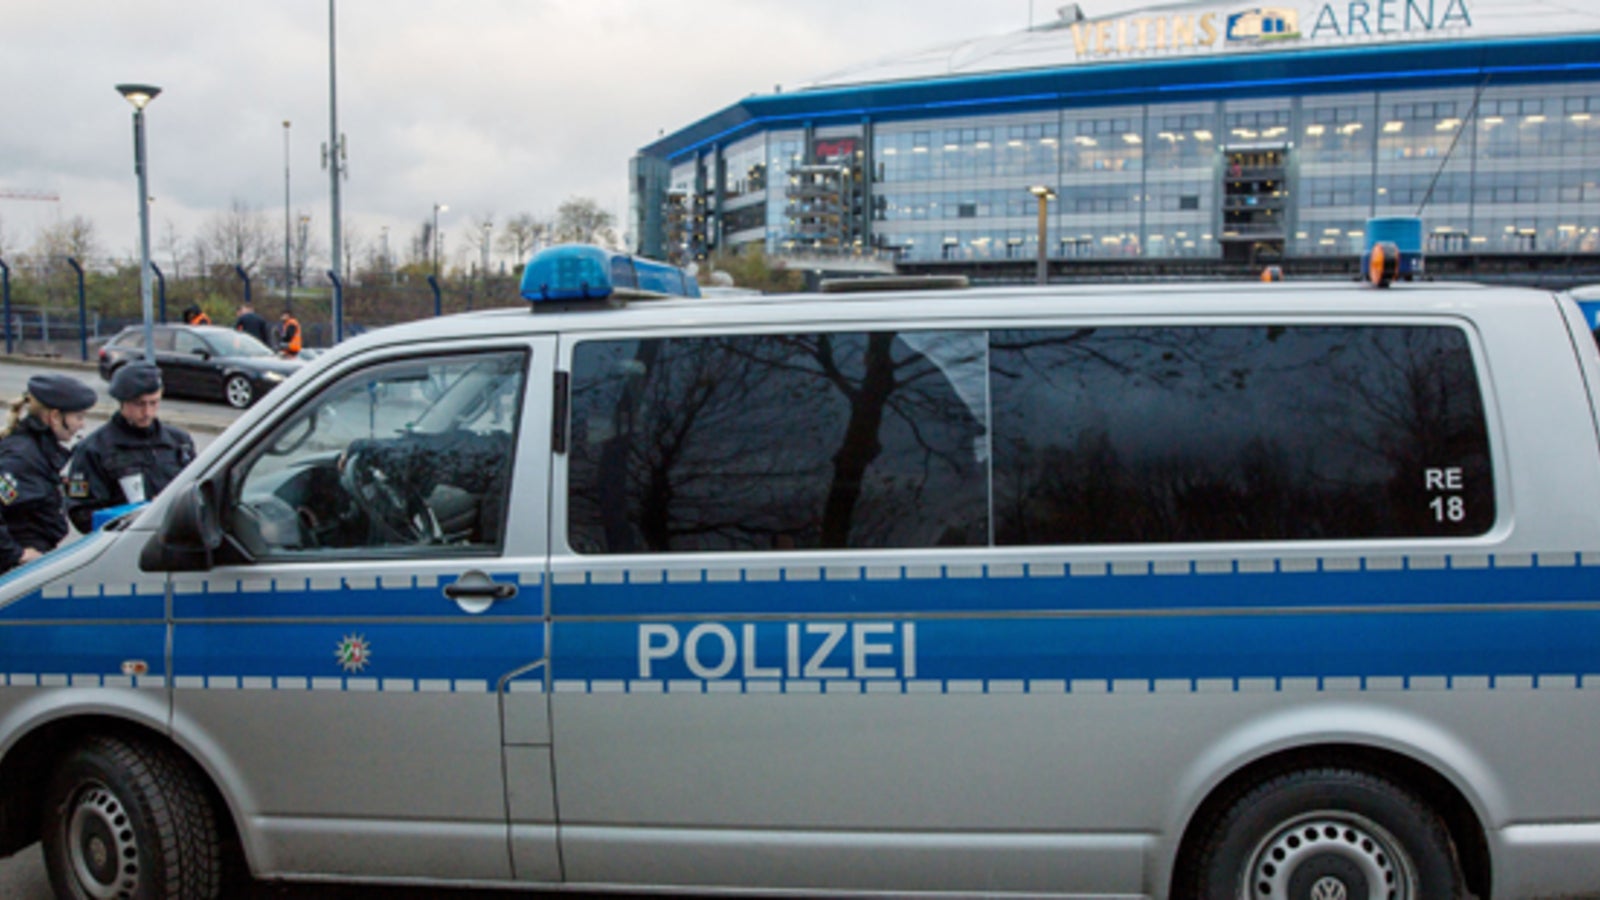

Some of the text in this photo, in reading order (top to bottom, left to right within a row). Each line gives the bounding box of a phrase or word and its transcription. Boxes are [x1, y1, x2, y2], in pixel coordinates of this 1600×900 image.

[1070, 0, 1472, 54] VELTINS ARENA
[1425, 467, 1463, 490] RE
[1429, 496, 1466, 522] 18
[638, 622, 916, 679] POLIZEI
